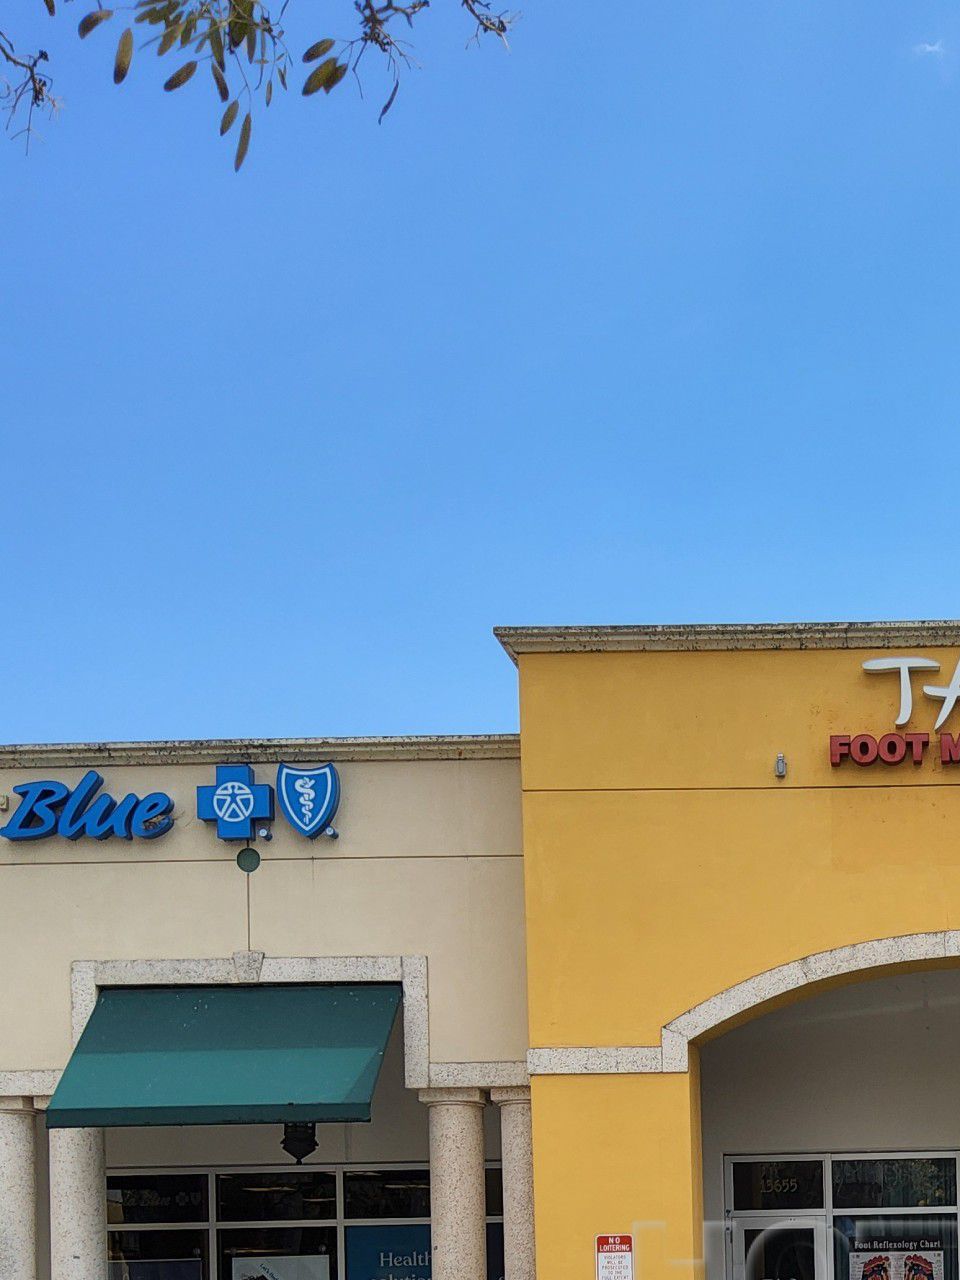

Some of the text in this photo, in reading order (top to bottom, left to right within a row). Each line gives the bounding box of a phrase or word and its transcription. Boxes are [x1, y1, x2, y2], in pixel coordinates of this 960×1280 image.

[829, 733, 929, 767] FOOT
[0, 770, 175, 841] Blue
[608, 1236, 621, 1244] NO
[854, 1239, 941, 1250] Foot Reflexology Chart
[599, 1244, 630, 1252] LOITERING
